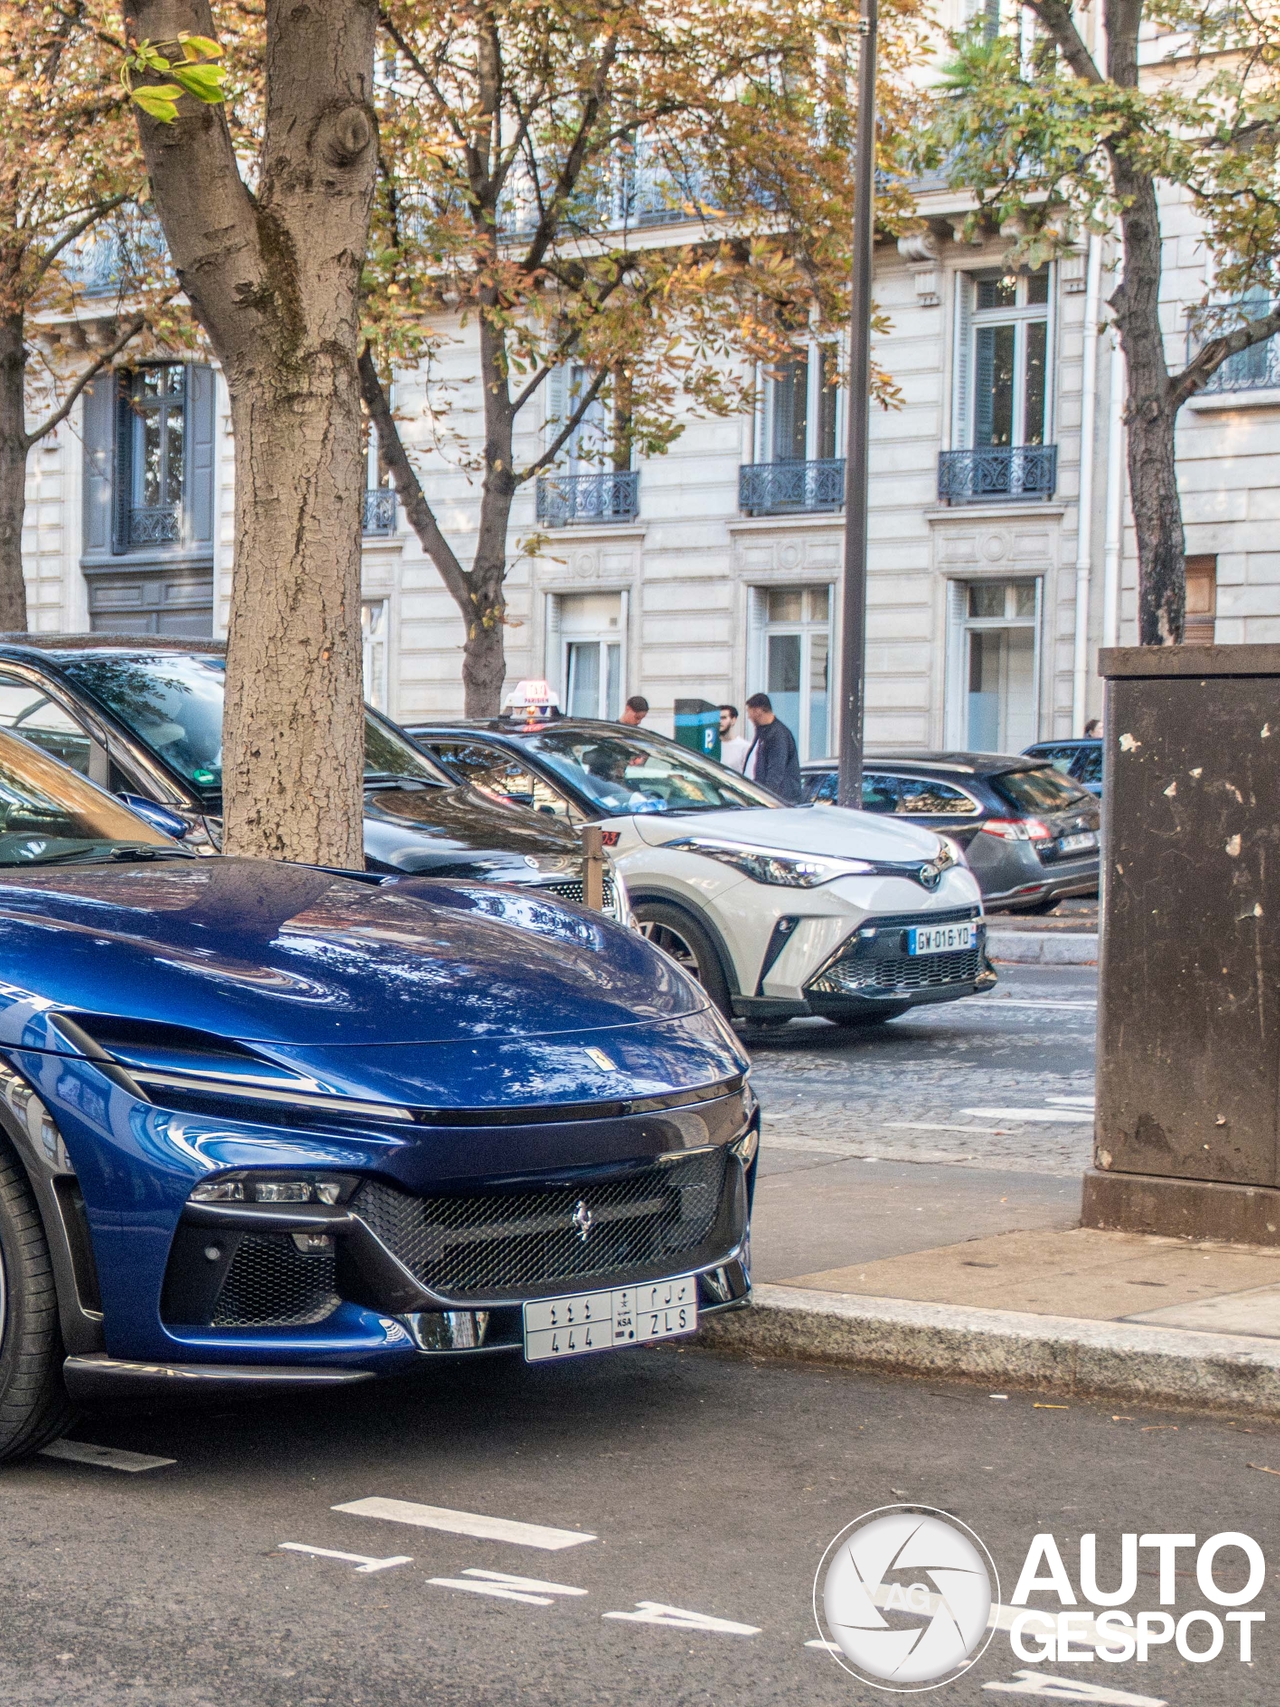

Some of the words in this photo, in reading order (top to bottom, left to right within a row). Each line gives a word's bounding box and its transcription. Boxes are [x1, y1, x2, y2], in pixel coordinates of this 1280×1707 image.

[918, 927, 969, 950] GW-016-YD
[551, 1327, 592, 1353] 444
[650, 1308, 686, 1335] ZLS
[617, 1317, 632, 1328] KSA
